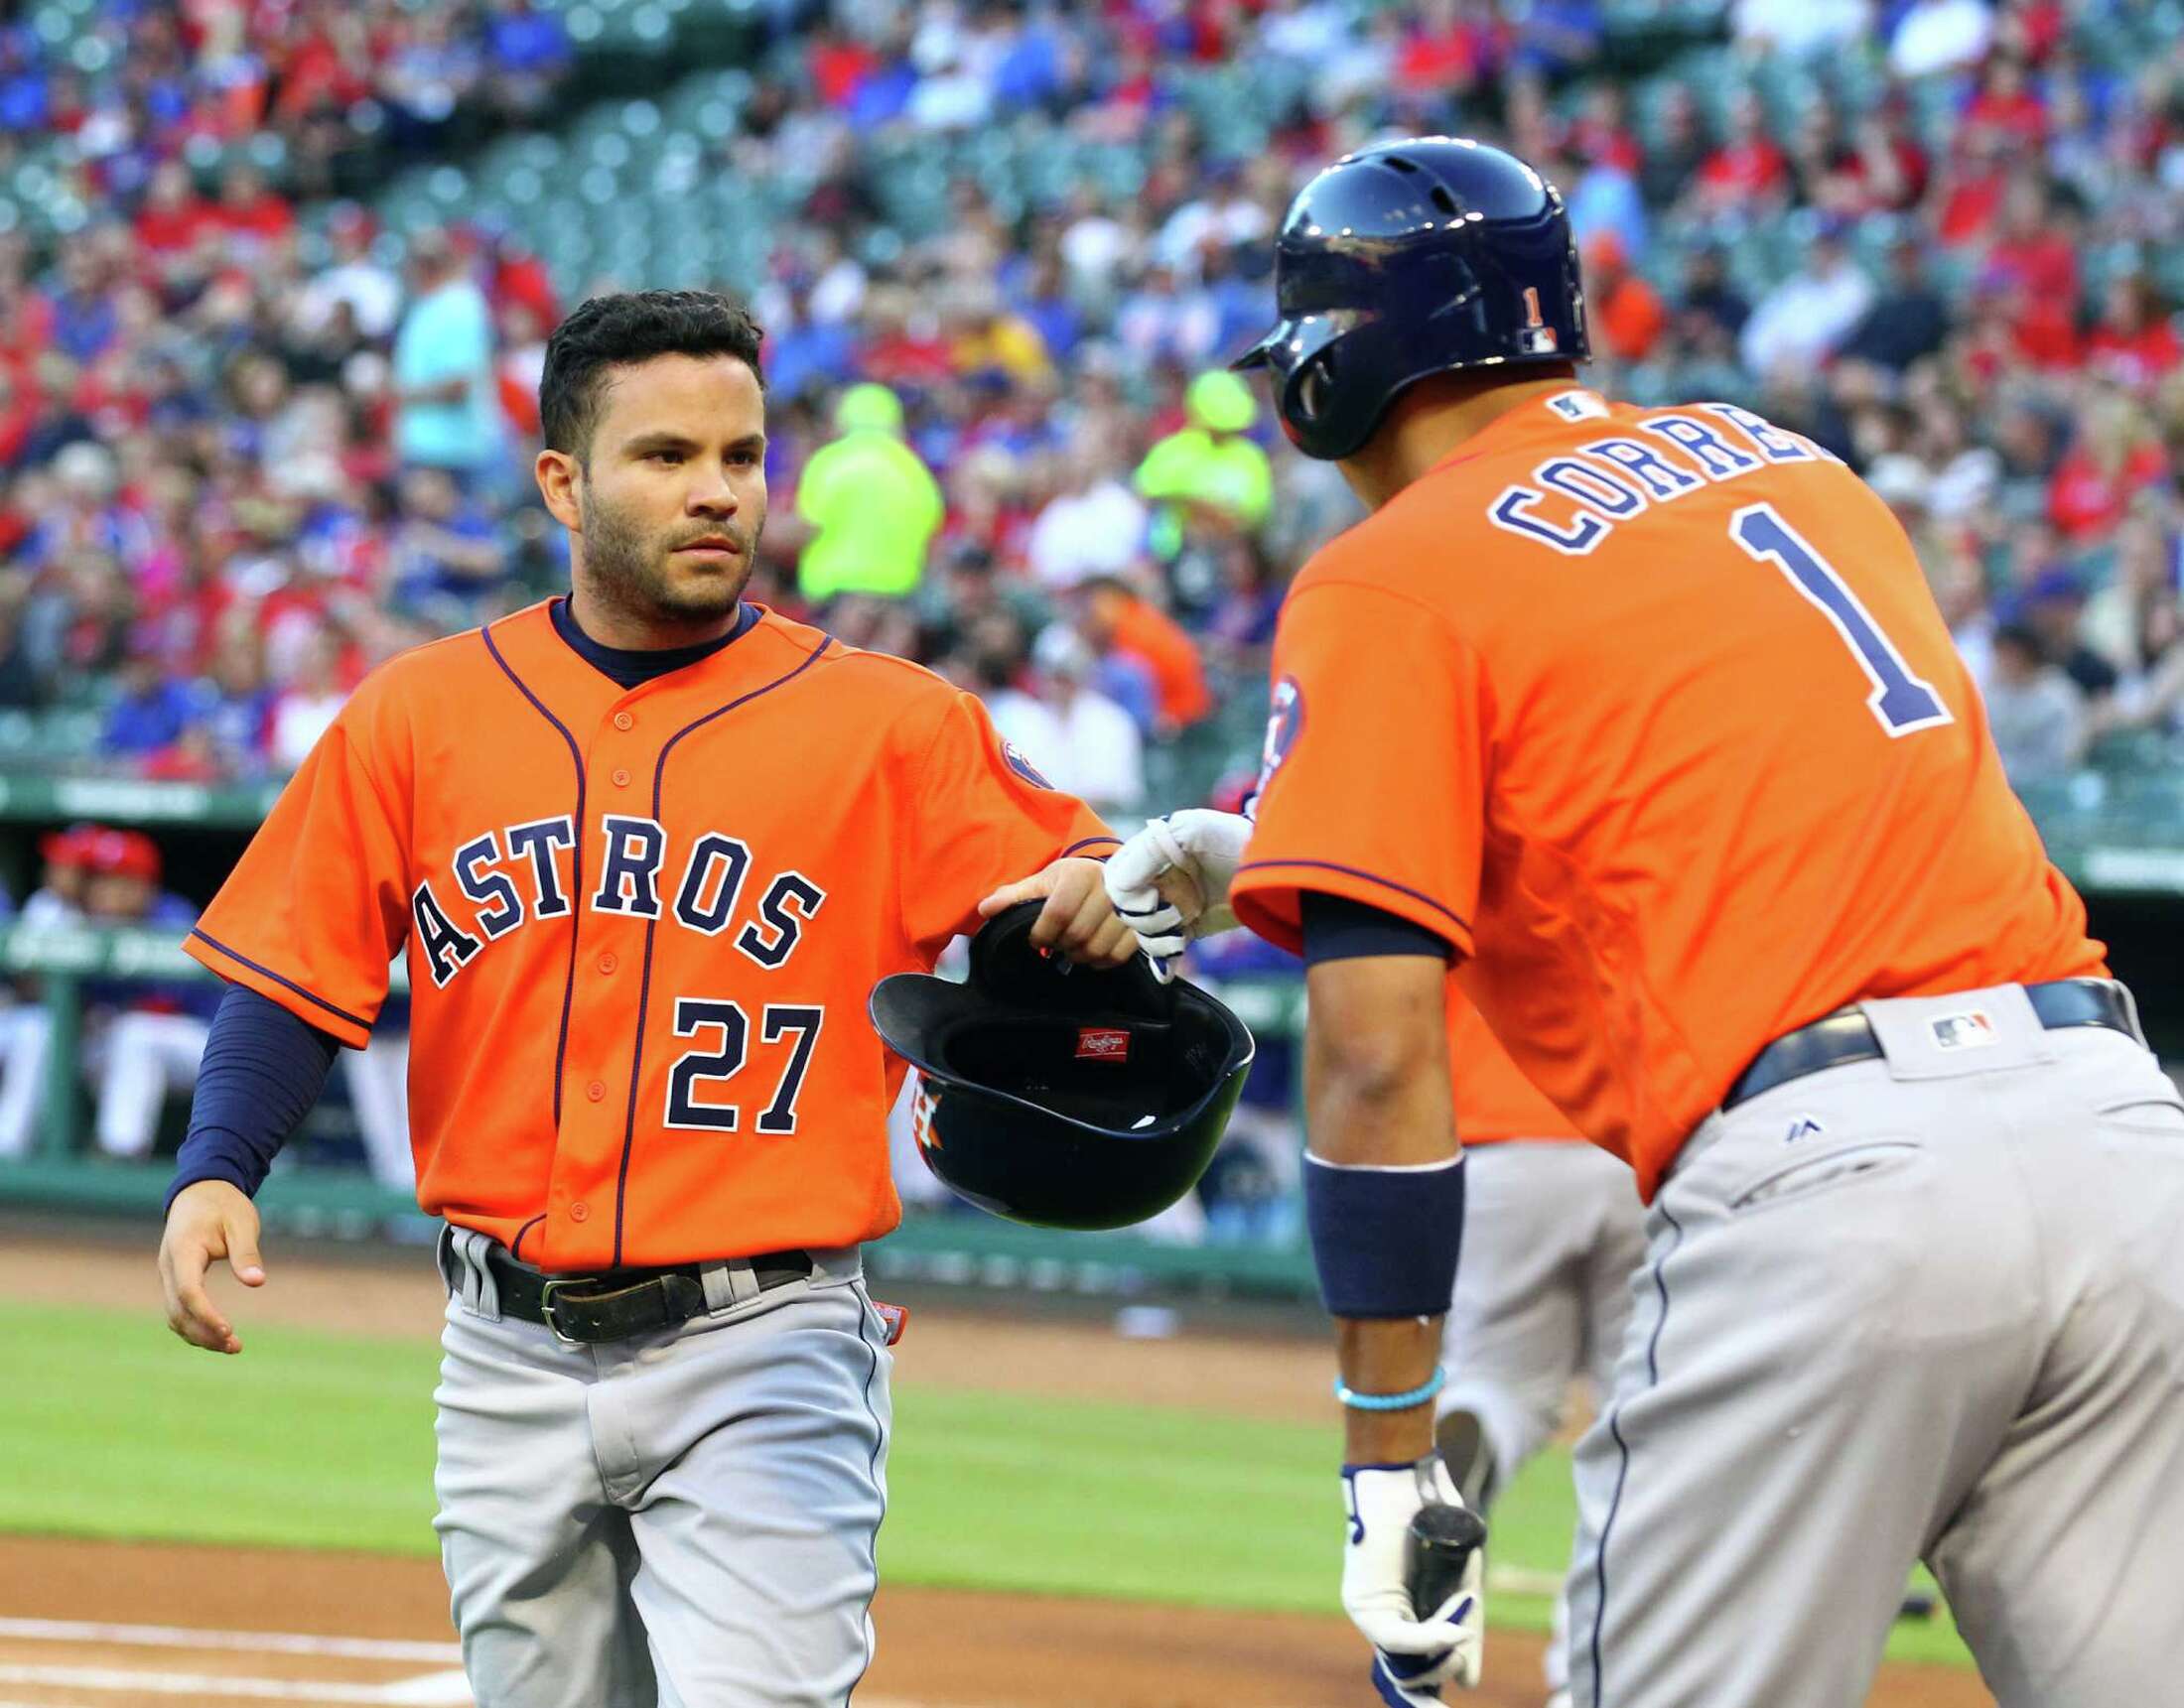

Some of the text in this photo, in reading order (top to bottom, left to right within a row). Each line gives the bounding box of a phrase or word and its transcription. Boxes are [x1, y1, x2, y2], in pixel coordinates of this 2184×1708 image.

[1523, 287, 1543, 328] 1
[1487, 403, 1846, 555] CORRE
[1729, 503, 1952, 736] 1
[412, 814, 827, 988] ASTROS
[663, 997, 825, 1134] 27
